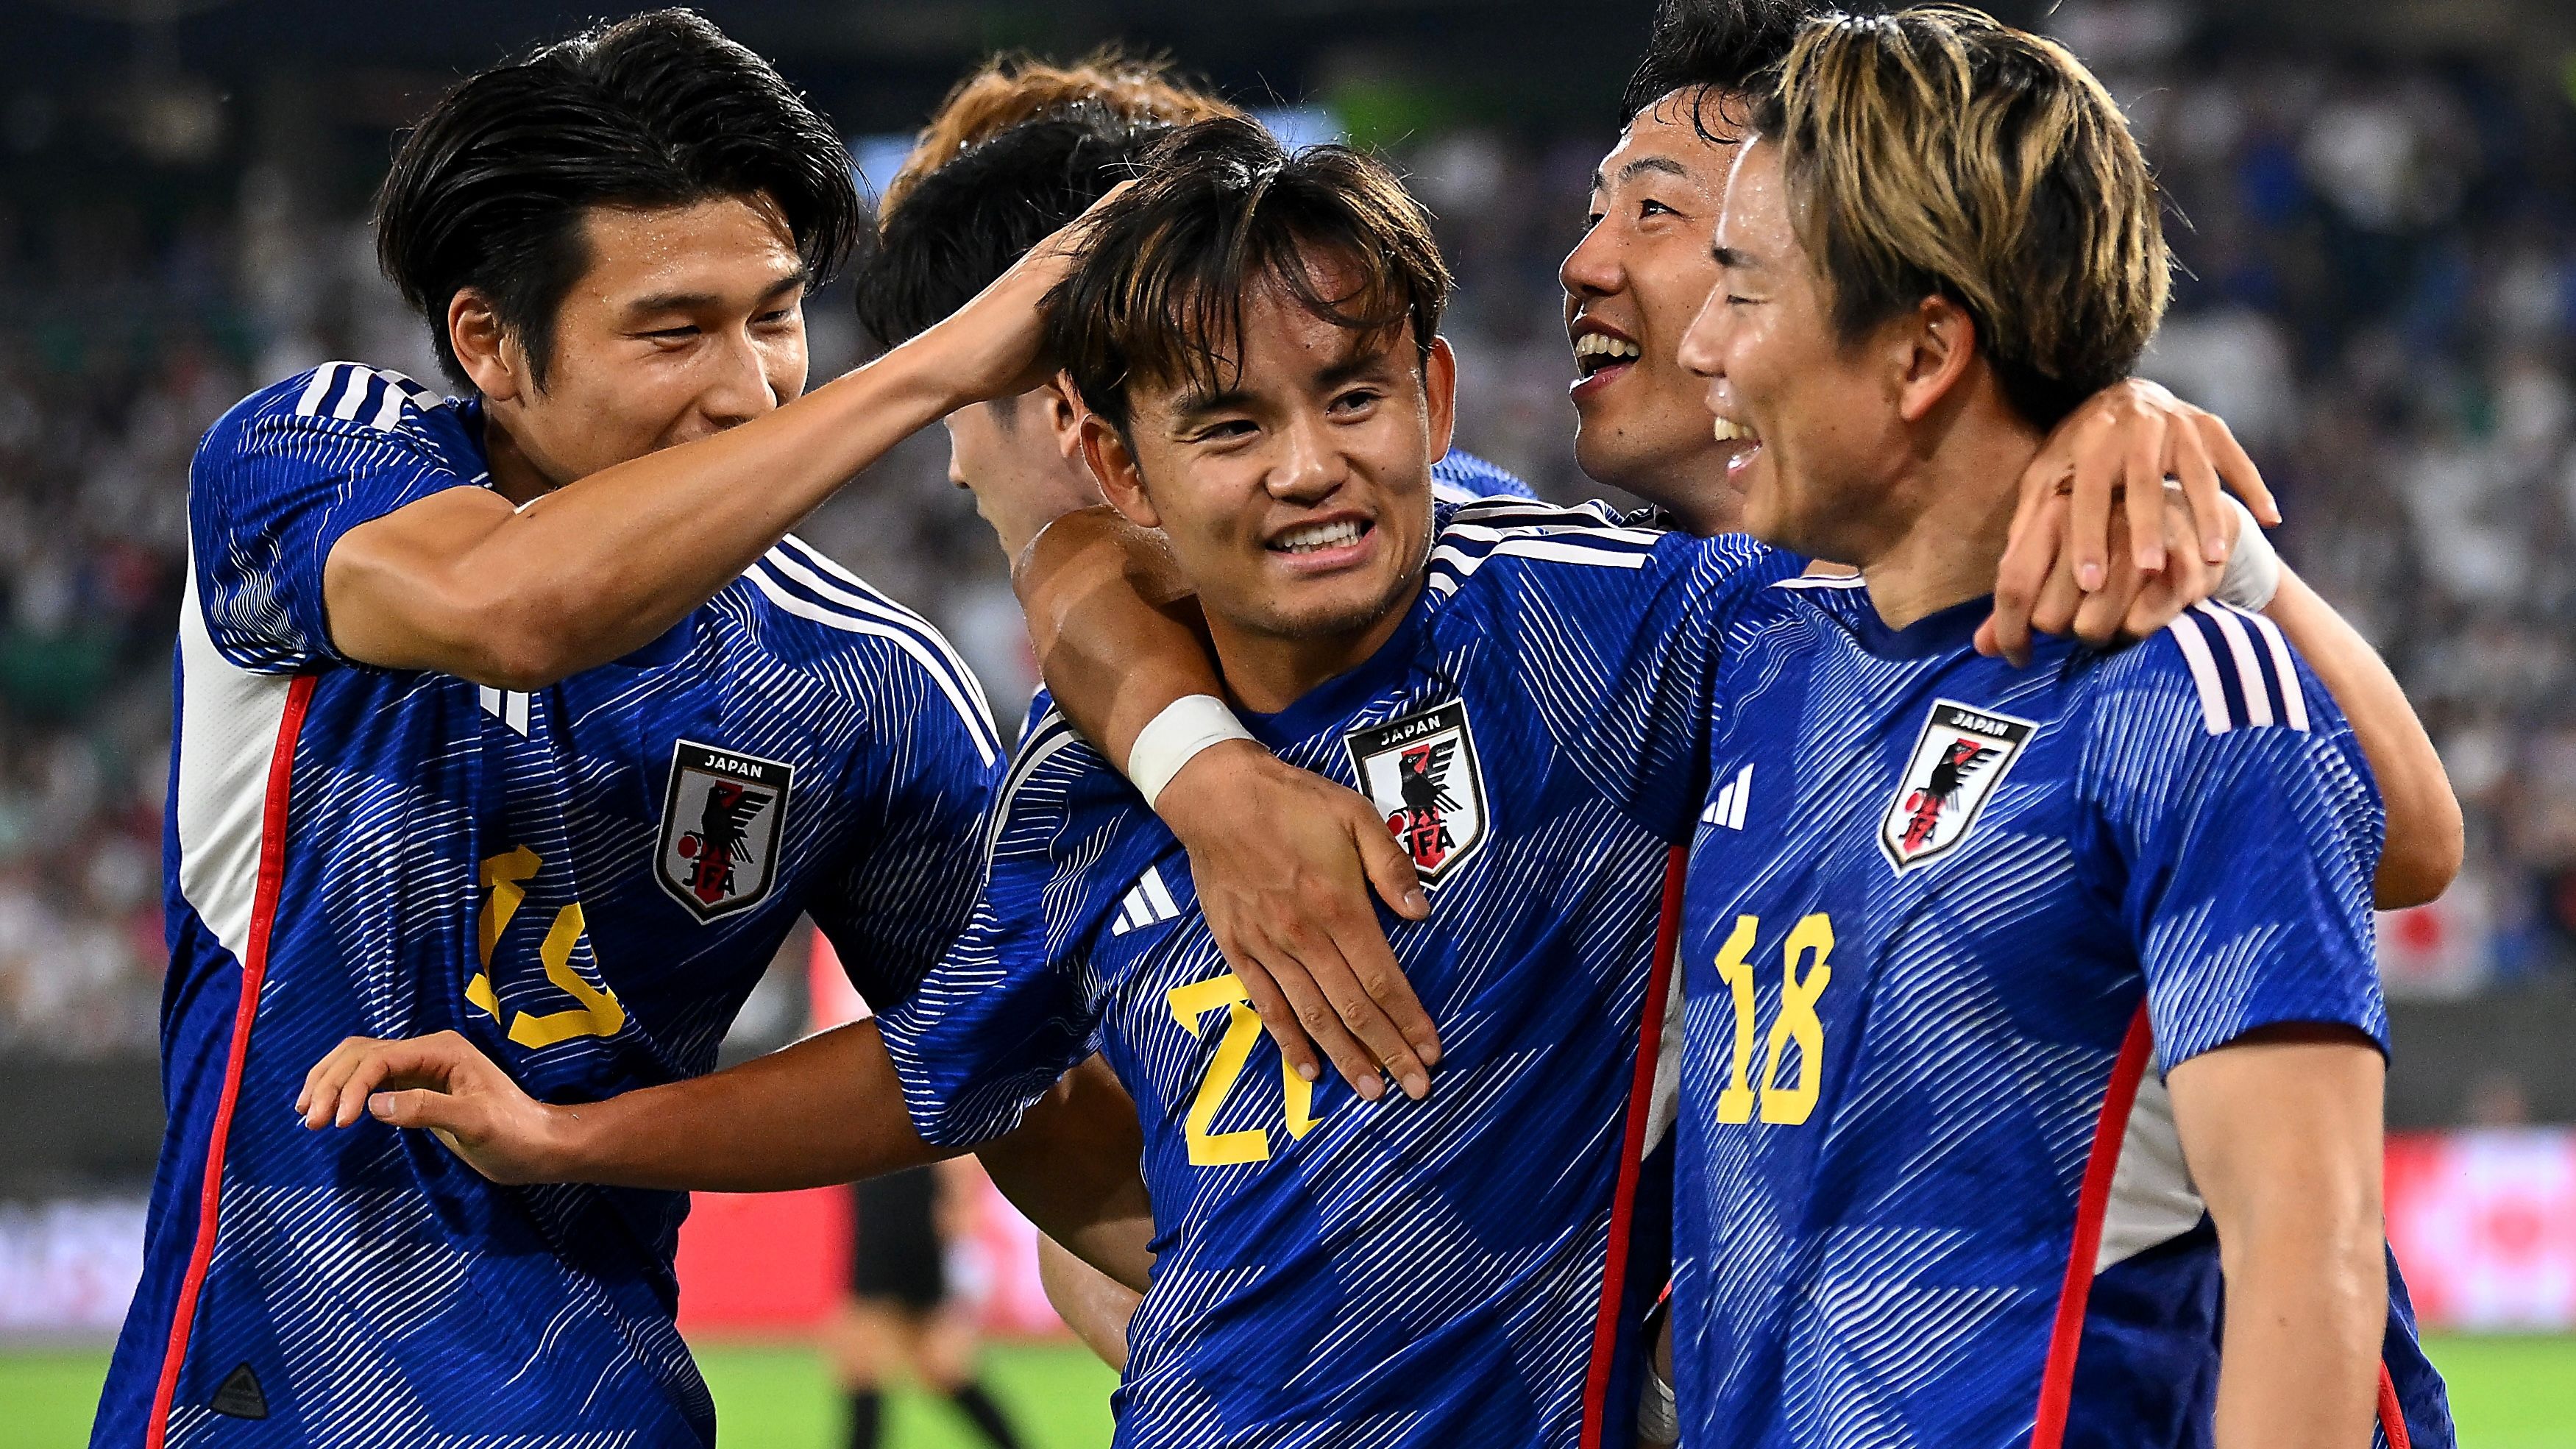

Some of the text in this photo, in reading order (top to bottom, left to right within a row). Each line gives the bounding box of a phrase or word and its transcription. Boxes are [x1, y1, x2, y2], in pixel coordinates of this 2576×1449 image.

[1381, 715, 1441, 745] JAPAN
[1951, 711, 2009, 736] JAPAN
[705, 755, 762, 778] JAPAN
[682, 862, 737, 896] JFA
[1714, 912, 1835, 1125] 18
